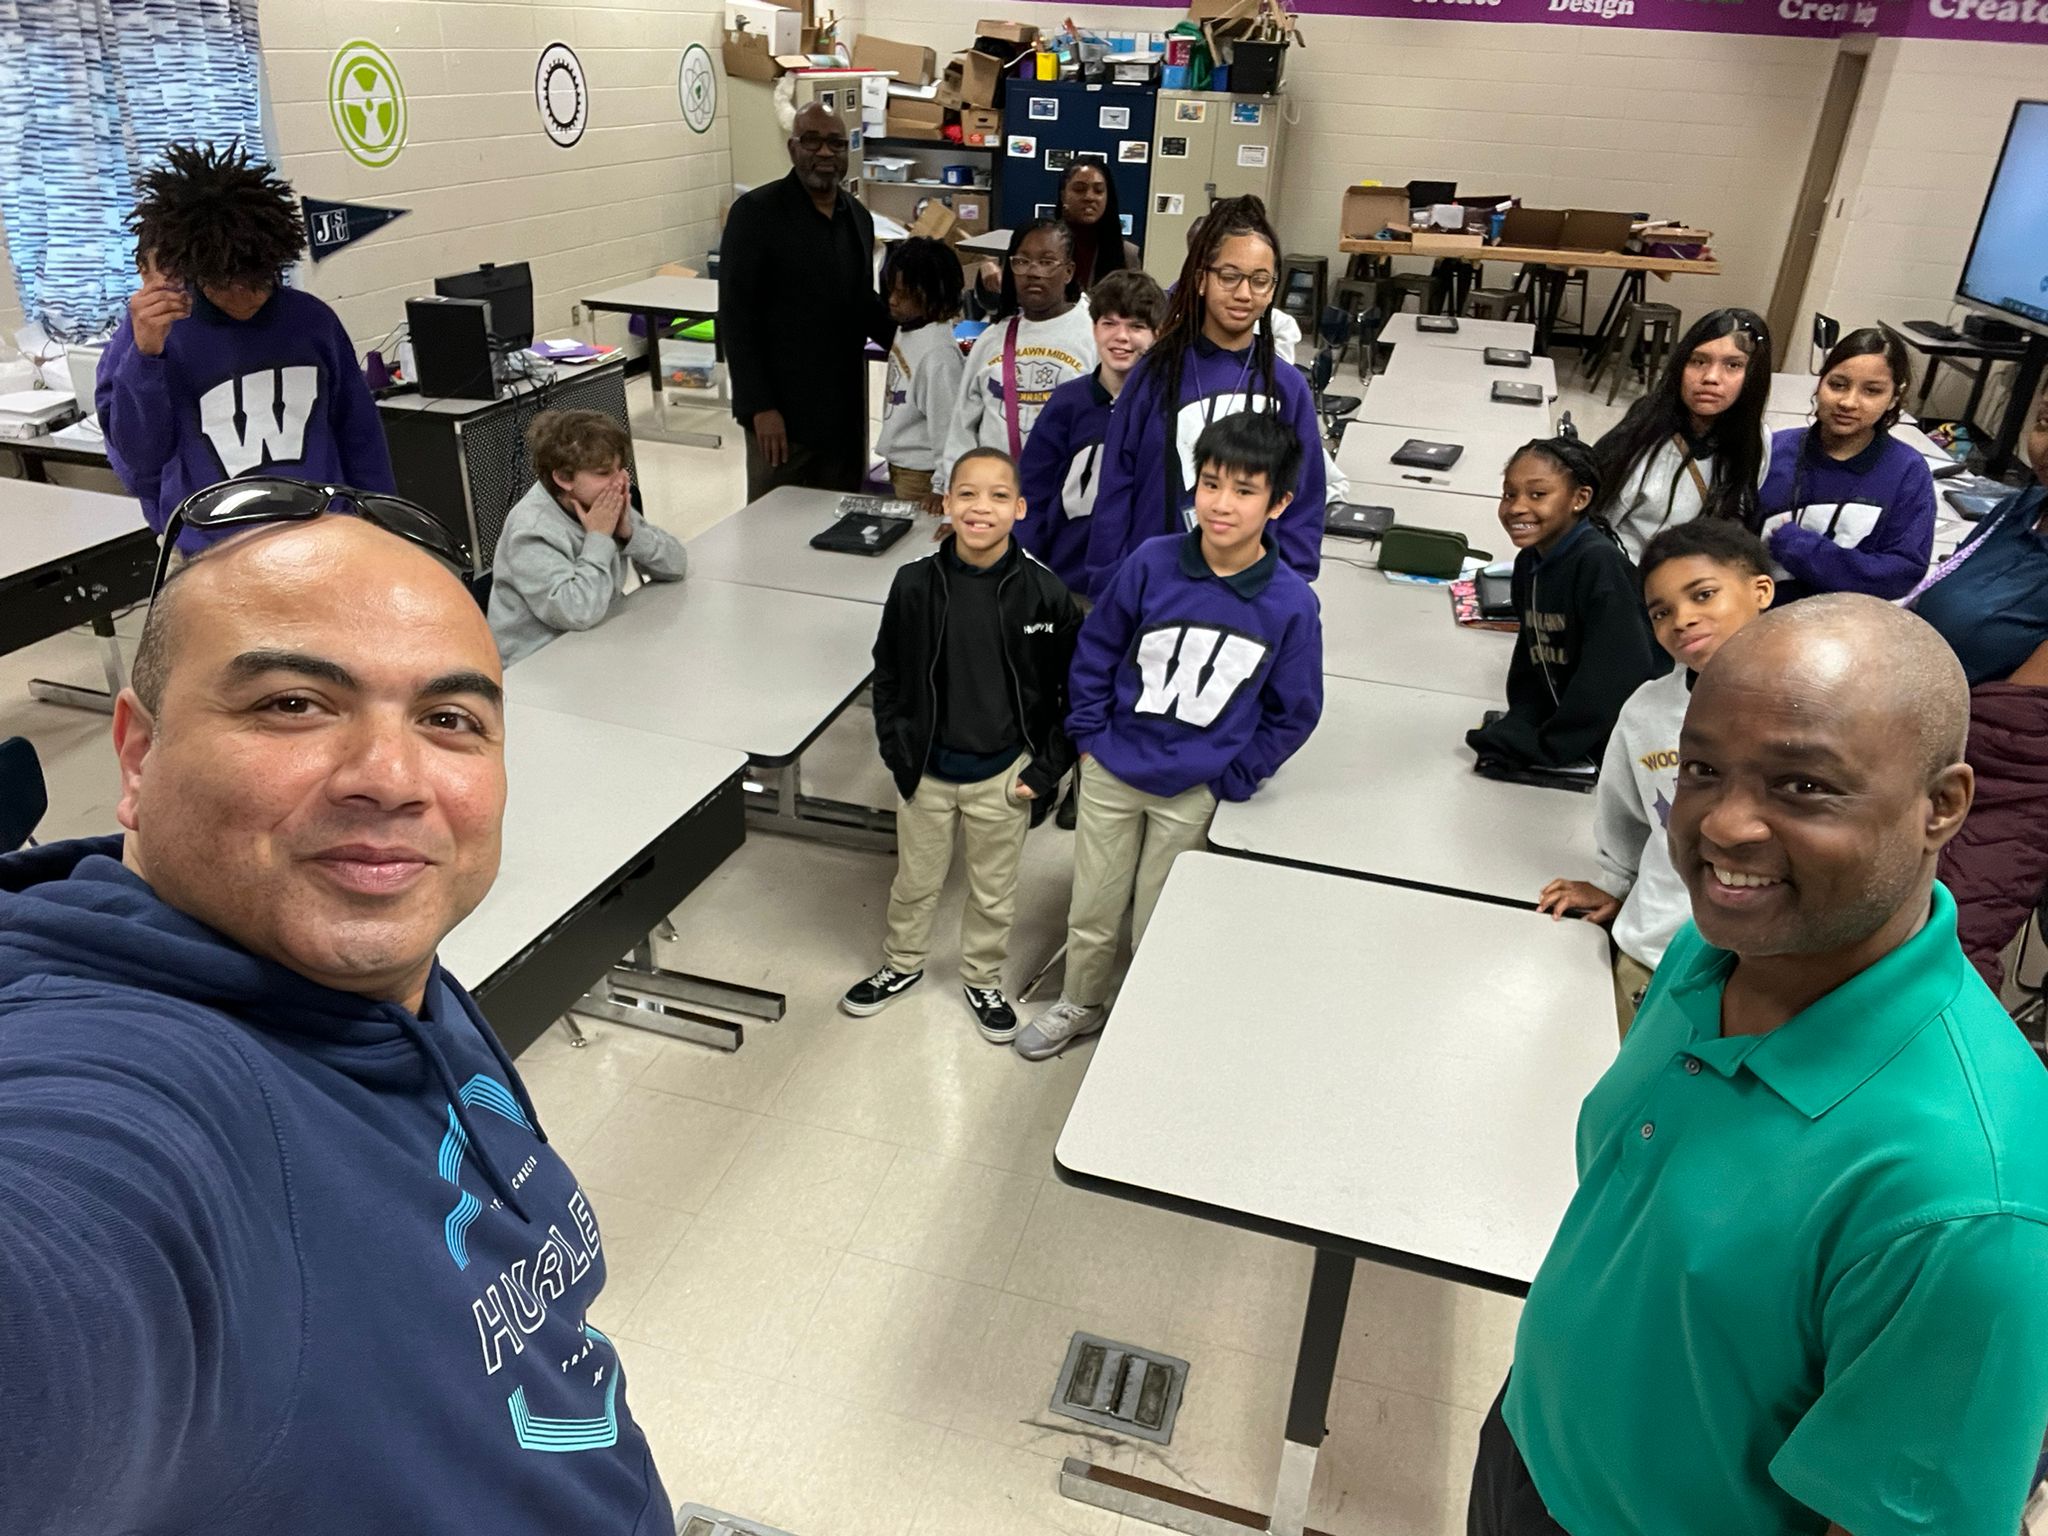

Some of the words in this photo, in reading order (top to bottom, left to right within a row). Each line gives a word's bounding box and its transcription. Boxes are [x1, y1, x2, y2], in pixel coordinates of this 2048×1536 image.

[1548, 0, 1635, 19] Design
[200, 366, 318, 480] W
[1134, 626, 1267, 728] W
[472, 1186, 600, 1376] HURLE
